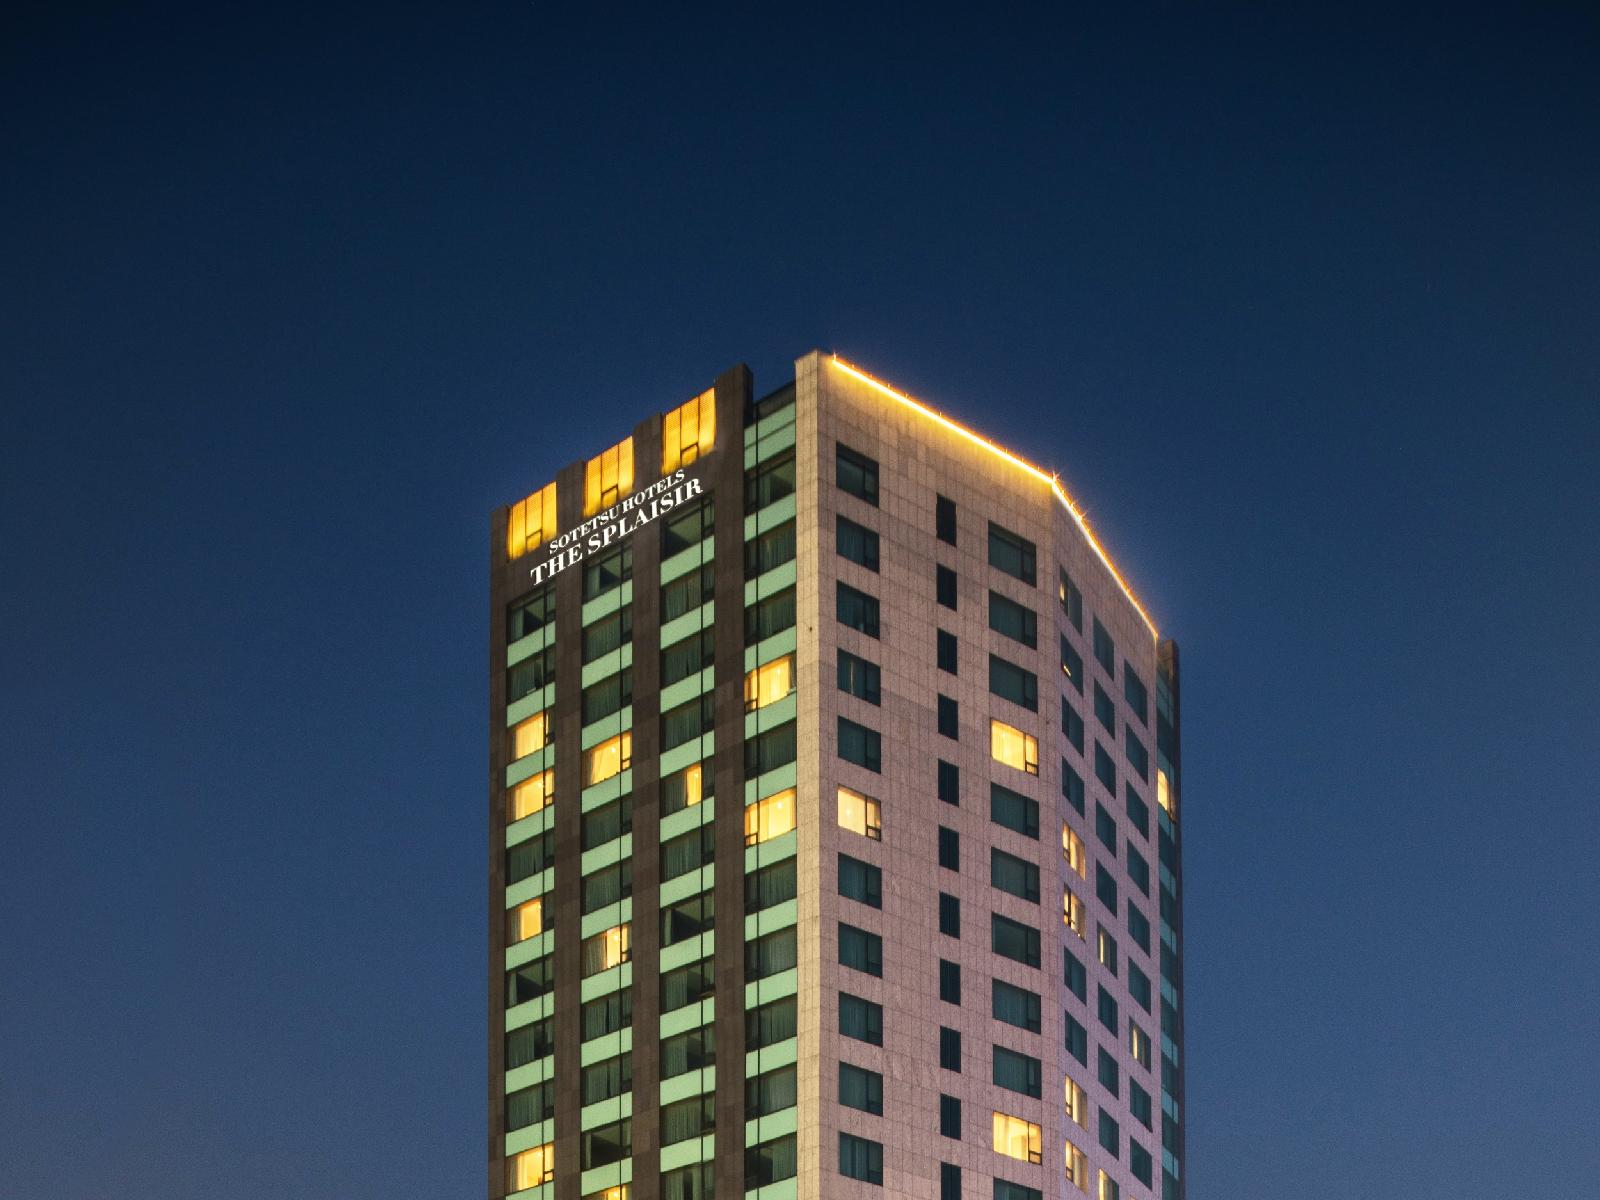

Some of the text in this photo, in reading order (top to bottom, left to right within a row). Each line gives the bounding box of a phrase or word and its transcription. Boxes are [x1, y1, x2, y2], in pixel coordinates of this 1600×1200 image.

[530, 478, 703, 586] THE SPLAISIR
[549, 468, 685, 555] SOTETSU HOTELS
